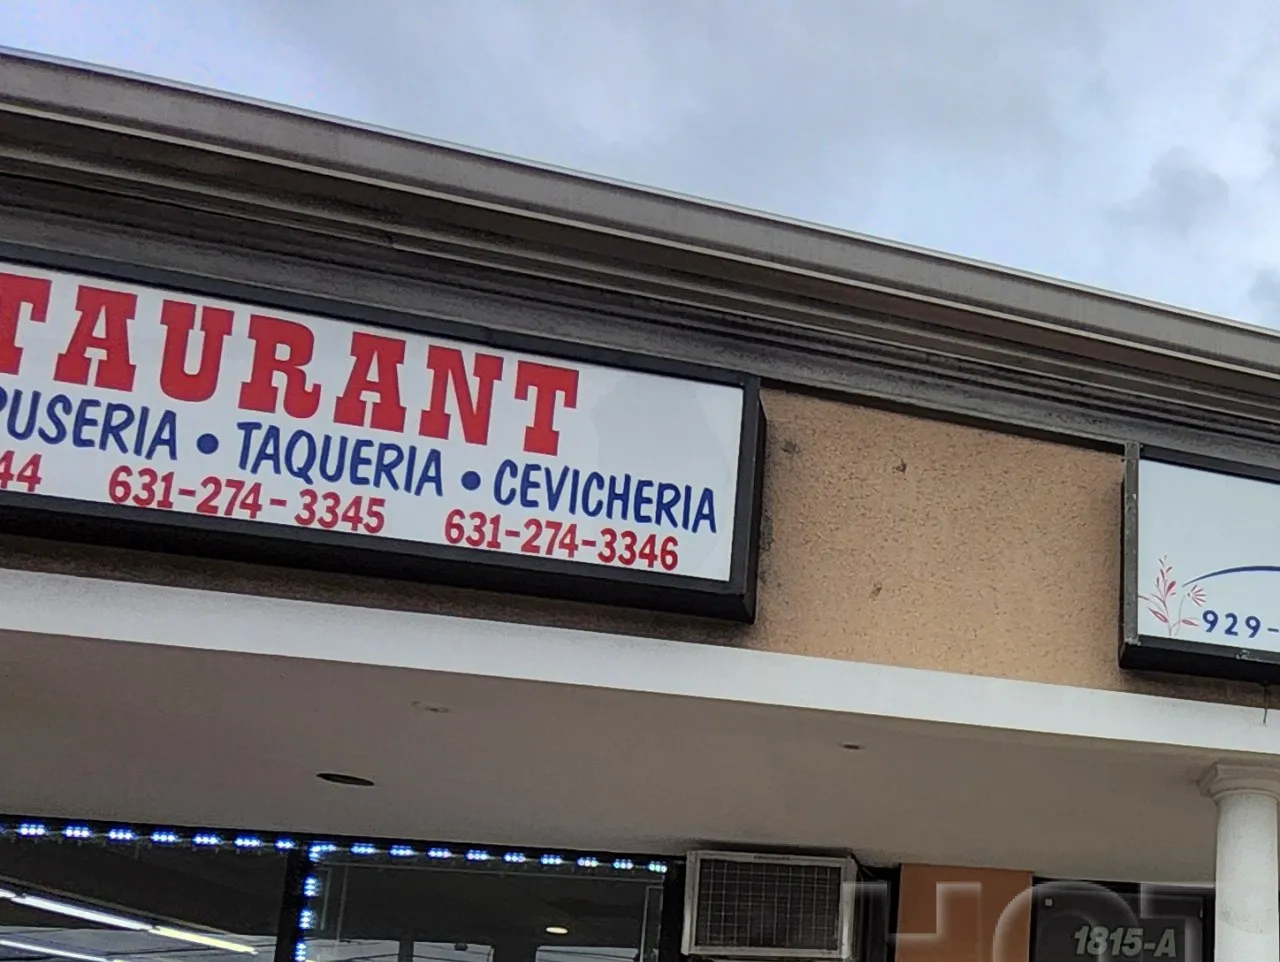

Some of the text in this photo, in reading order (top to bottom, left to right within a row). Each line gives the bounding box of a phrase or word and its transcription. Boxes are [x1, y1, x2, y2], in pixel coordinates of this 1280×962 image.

[109, 465, 385, 534] 631-274-3345
[444, 509, 679, 571] 631-274-3346
[236, 421, 444, 497] TAQUERIA
[493, 459, 717, 534] CEVICHERIA
[1074, 925, 1177, 957] 1815-A
